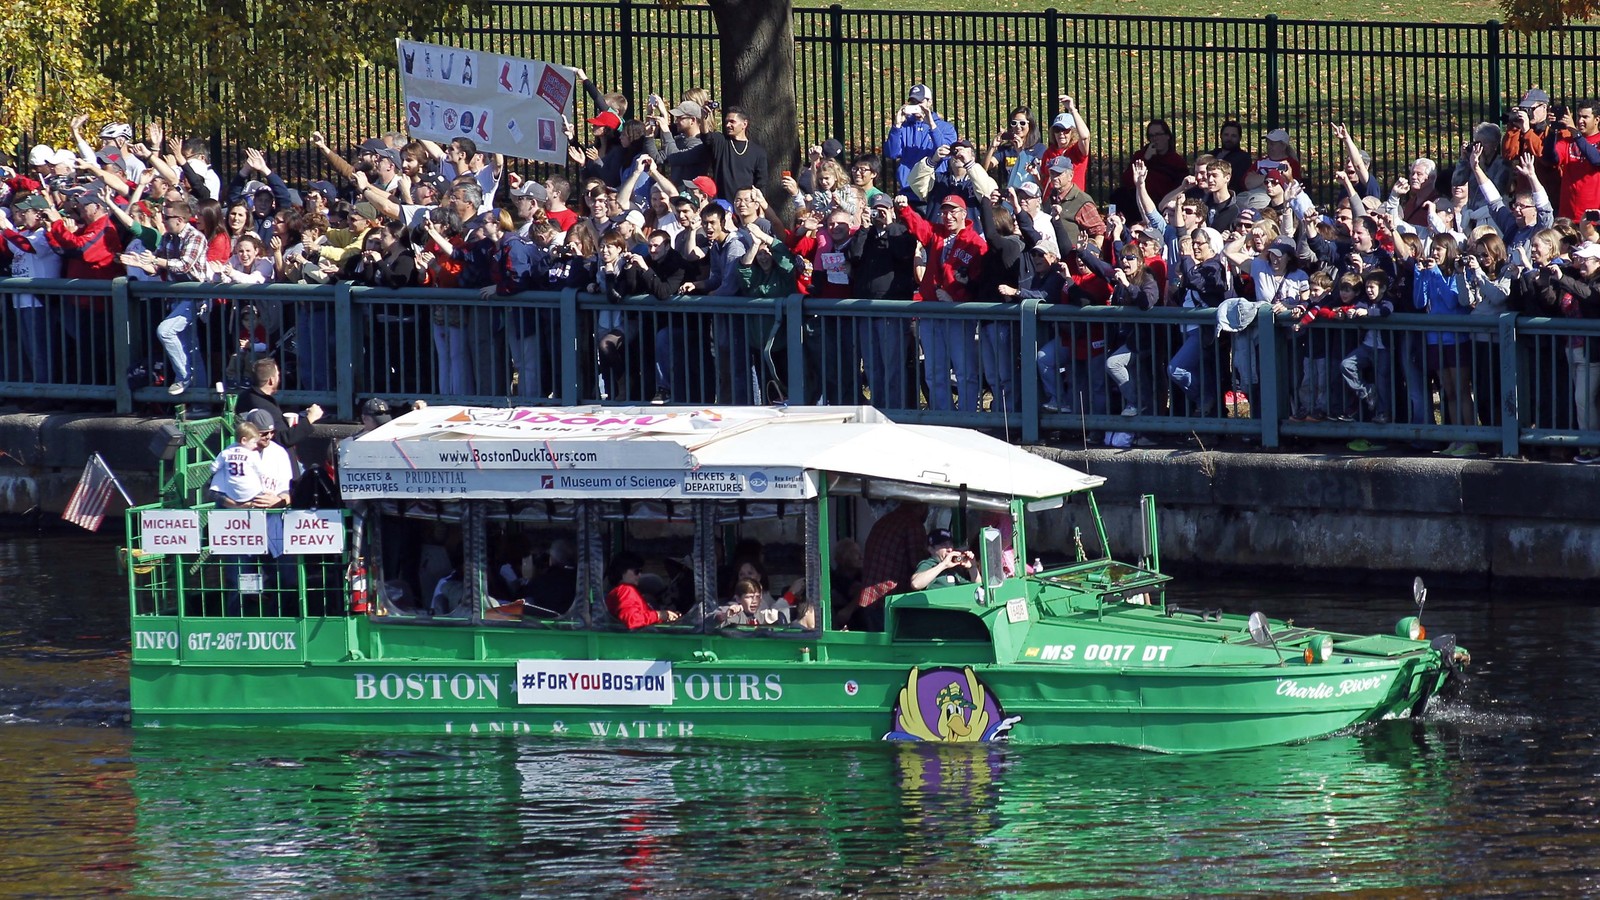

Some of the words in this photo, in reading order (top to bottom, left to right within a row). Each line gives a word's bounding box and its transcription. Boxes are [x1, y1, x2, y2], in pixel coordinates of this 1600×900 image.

[439, 448, 597, 463] www.BostonDuckTours.com
[229, 462, 245, 476] 31
[347, 472, 382, 482] TICKETS
[385, 472, 392, 481] &
[405, 471, 466, 484] PRUDENTIAL
[561, 476, 612, 487] Museum
[615, 476, 627, 487] of
[630, 475, 676, 487] Science
[690, 472, 725, 481] TICKETS
[730, 472, 737, 480] &
[342, 483, 399, 493] DEPARTURES
[406, 486, 467, 494] CENTER
[685, 482, 743, 492] DEPARTURES
[143, 519, 197, 529] MICHAEL
[225, 519, 251, 530] JON
[295, 519, 329, 530] JAKE
[154, 535, 187, 545] EGAN
[213, 535, 264, 546] LESTER
[290, 535, 335, 545] PEAVY
[135, 631, 179, 649] INFO
[188, 632, 296, 650] 617-267-DUCK
[1040, 644, 1076, 660] MS
[1083, 644, 1136, 661] 0017
[1142, 645, 1173, 661] DT
[354, 673, 500, 700] BOSTON
[671, 673, 783, 701] TOURS
[588, 720, 694, 738] WATER
